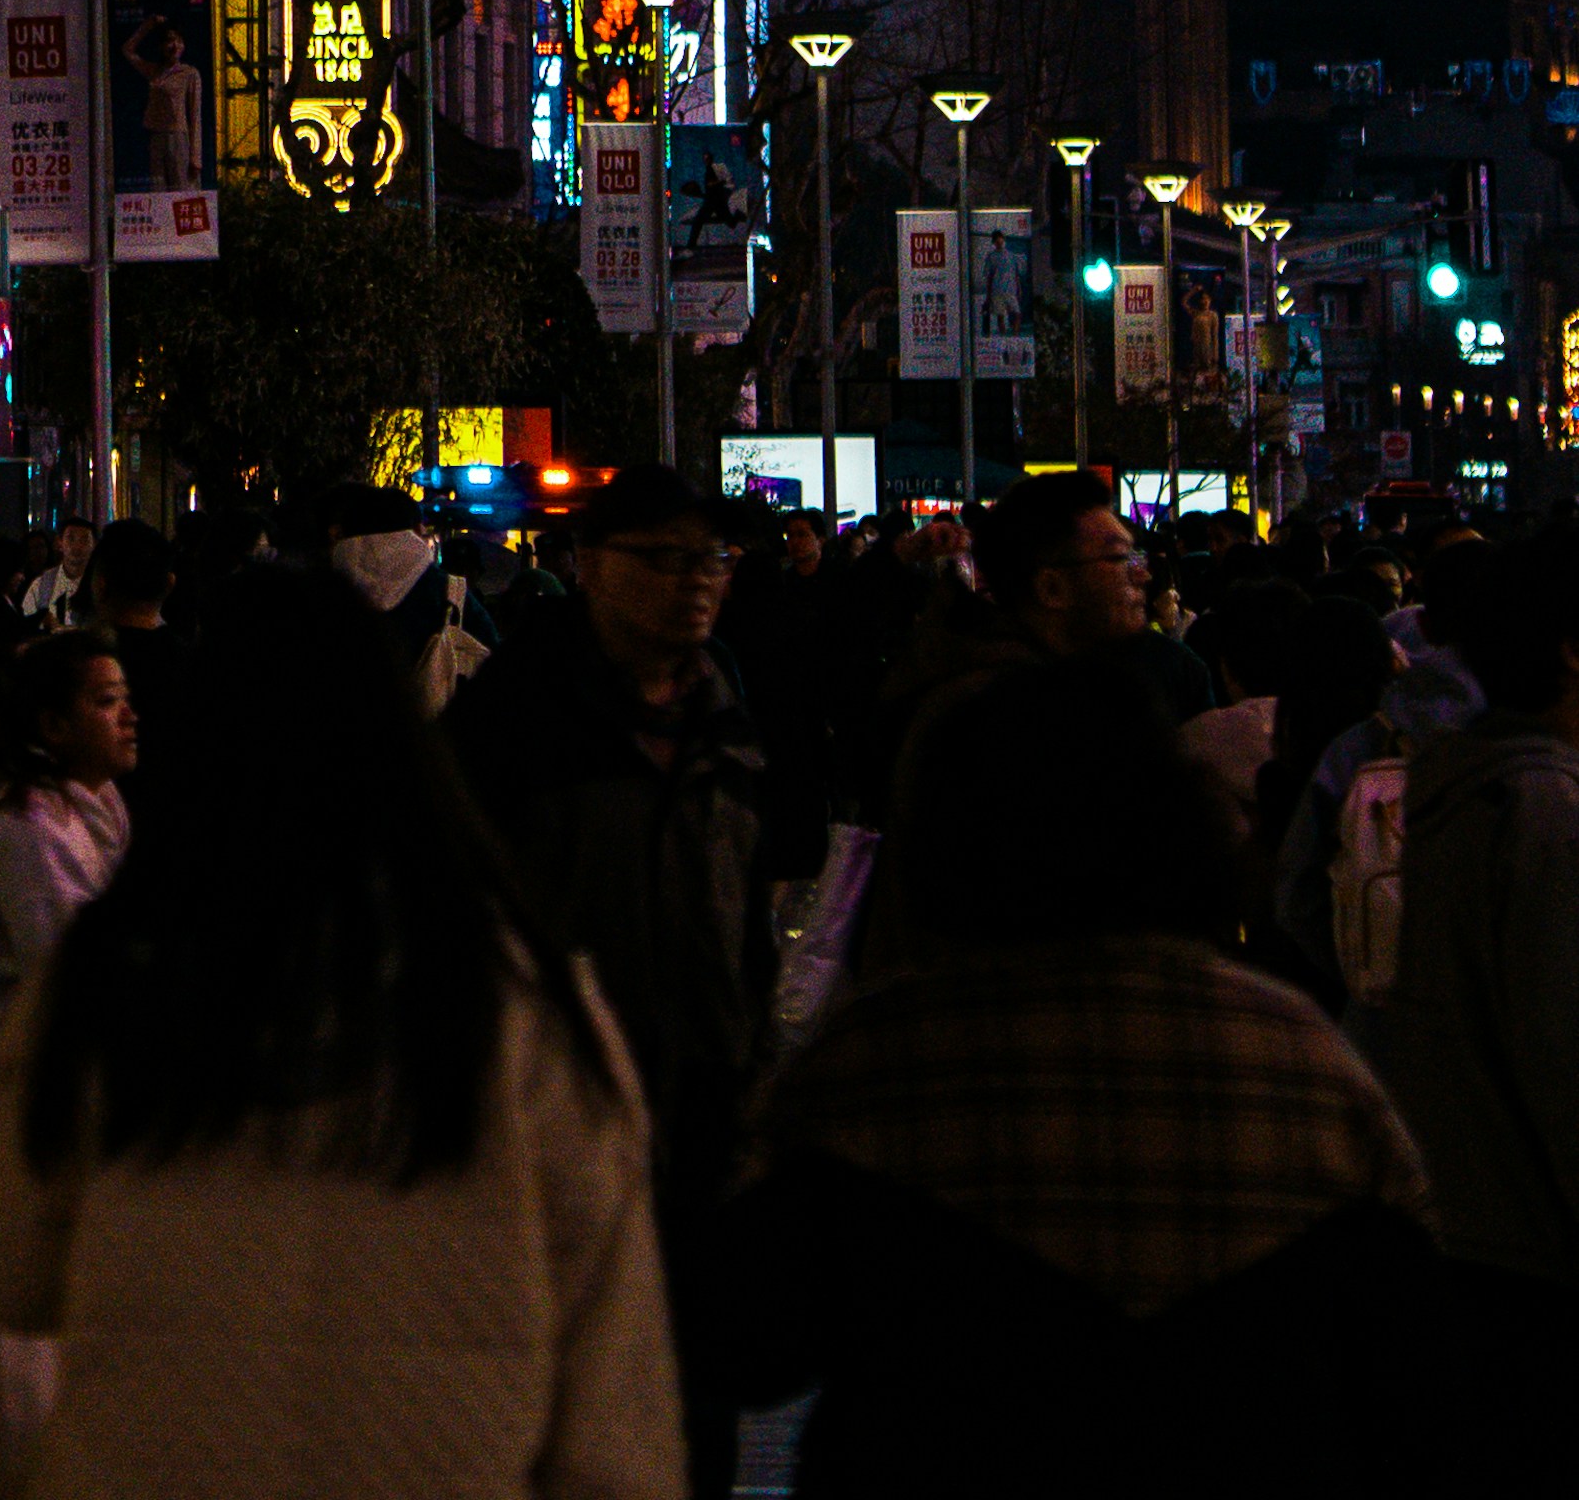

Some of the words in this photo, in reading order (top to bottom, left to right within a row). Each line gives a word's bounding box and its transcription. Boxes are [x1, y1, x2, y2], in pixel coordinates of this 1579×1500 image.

[14, 24, 55, 45] UNI
[306, 35, 373, 59] SINCE
[15, 49, 60, 74] QLO
[314, 58, 362, 82] 1848
[11, 121, 69, 139] 优衣库
[12, 154, 71, 176] 03.28
[602, 155, 633, 171] UNI
[602, 174, 636, 191] QLO
[914, 236, 940, 249] UNI
[914, 252, 942, 264] QLO
